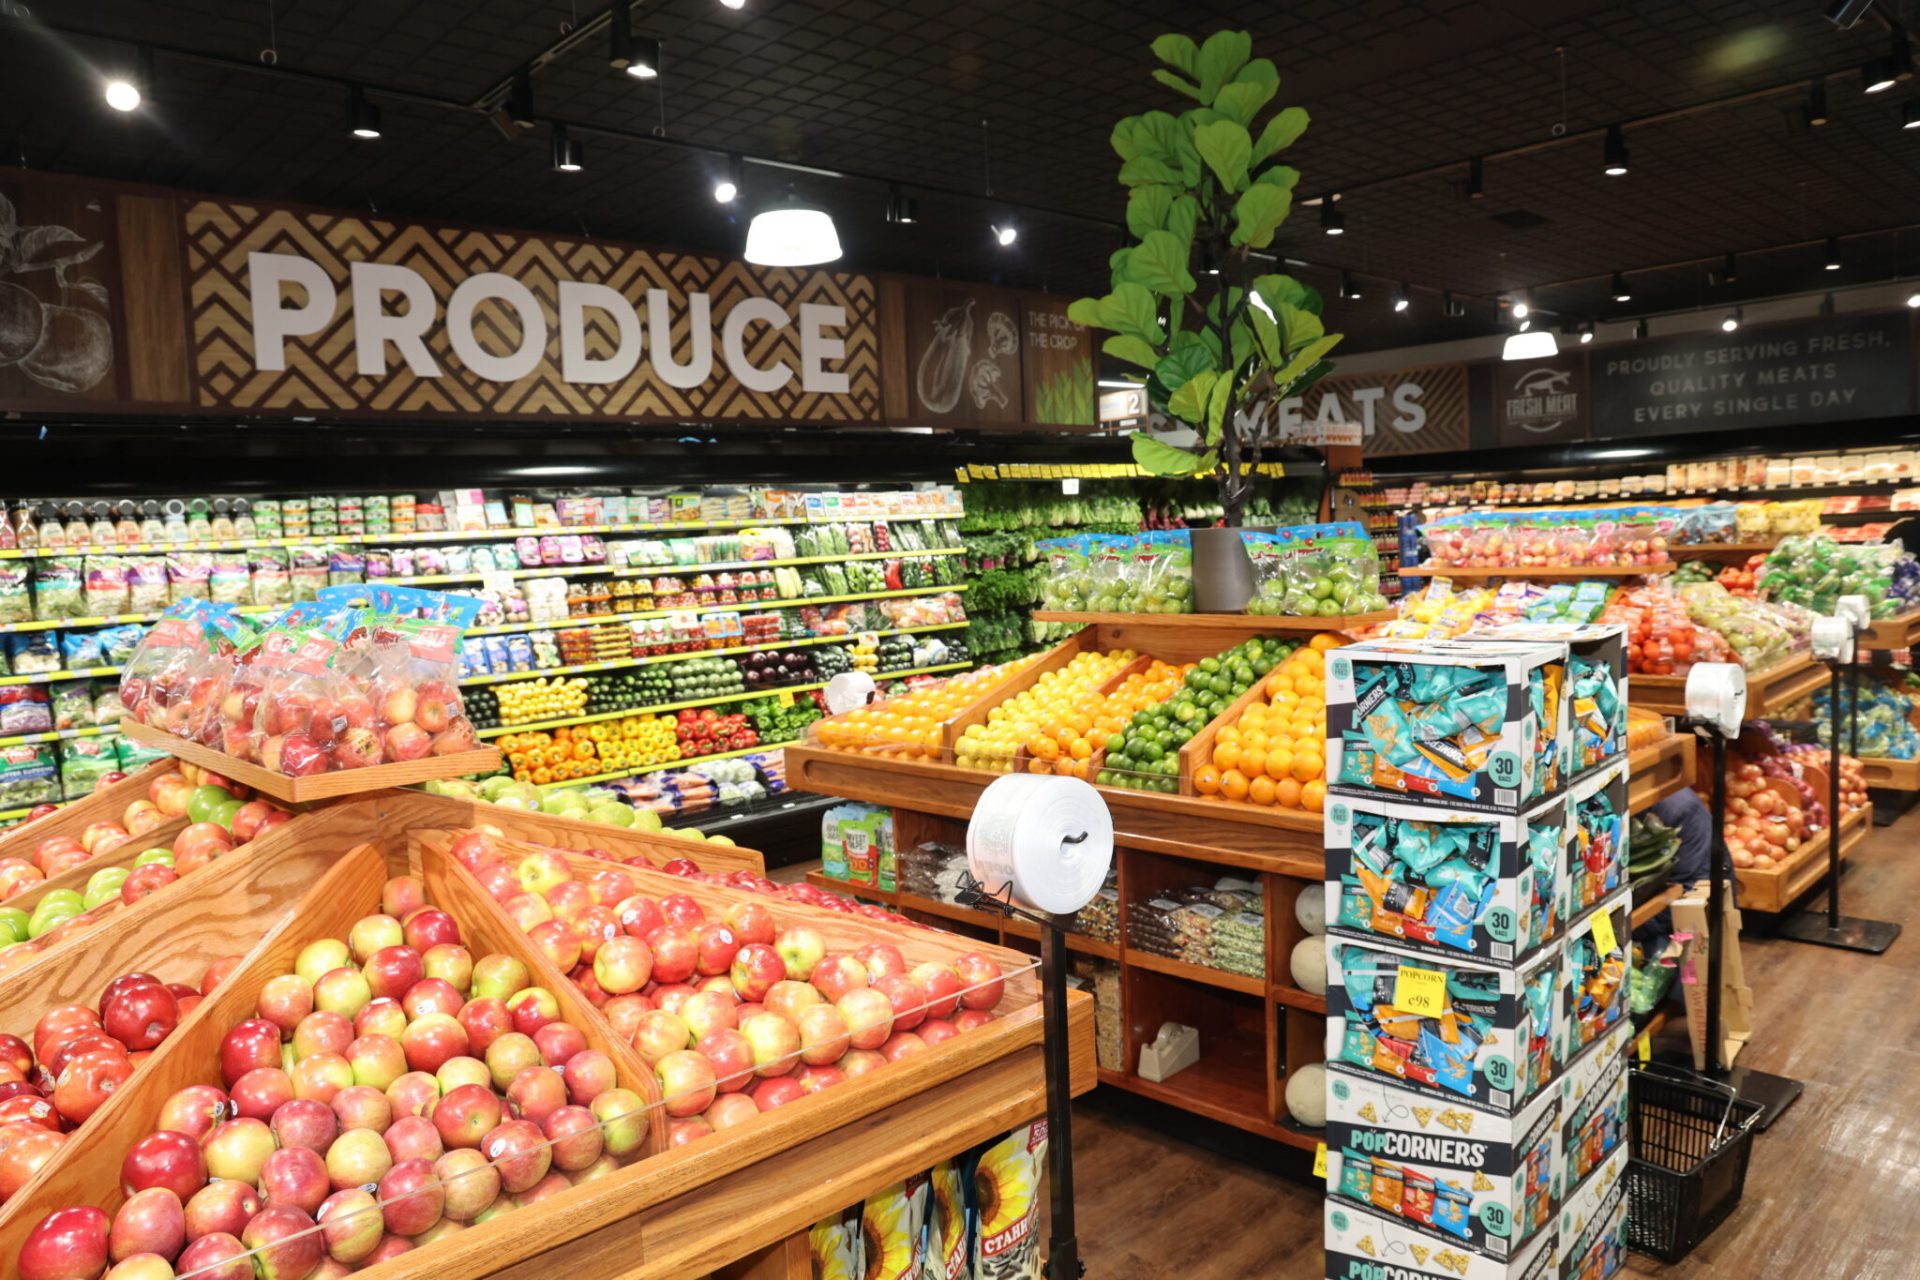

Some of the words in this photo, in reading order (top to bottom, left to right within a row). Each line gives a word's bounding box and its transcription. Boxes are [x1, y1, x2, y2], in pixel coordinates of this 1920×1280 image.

[249, 251, 850, 394] PRODUCE
[1028, 311, 1048, 327] THE
[1028, 332, 1048, 348] THE
[1049, 334, 1078, 350] CROP
[1607, 351, 1696, 376] PROUDLY
[1704, 340, 1798, 366] SERVING
[1807, 330, 1892, 354] FRESH,
[1650, 372, 1746, 397] QUALITY
[1757, 362, 1838, 386] MEATS
[1128, 393, 1140, 414] 2
[1233, 383, 1427, 441] MEATS
[1506, 397, 1543, 418] FRESH
[1634, 402, 1703, 423] EVERY
[1713, 393, 1799, 416] SINGLE
[1810, 388, 1857, 409] DAY
[1495, 757, 1513, 775] 30
[1491, 912, 1509, 930] 30
[1400, 969, 1445, 984] POPCORN
[1490, 1060, 1507, 1079] 30
[1351, 1129, 1485, 1168] POPCORNERS
[1486, 1206, 1504, 1225] 30
